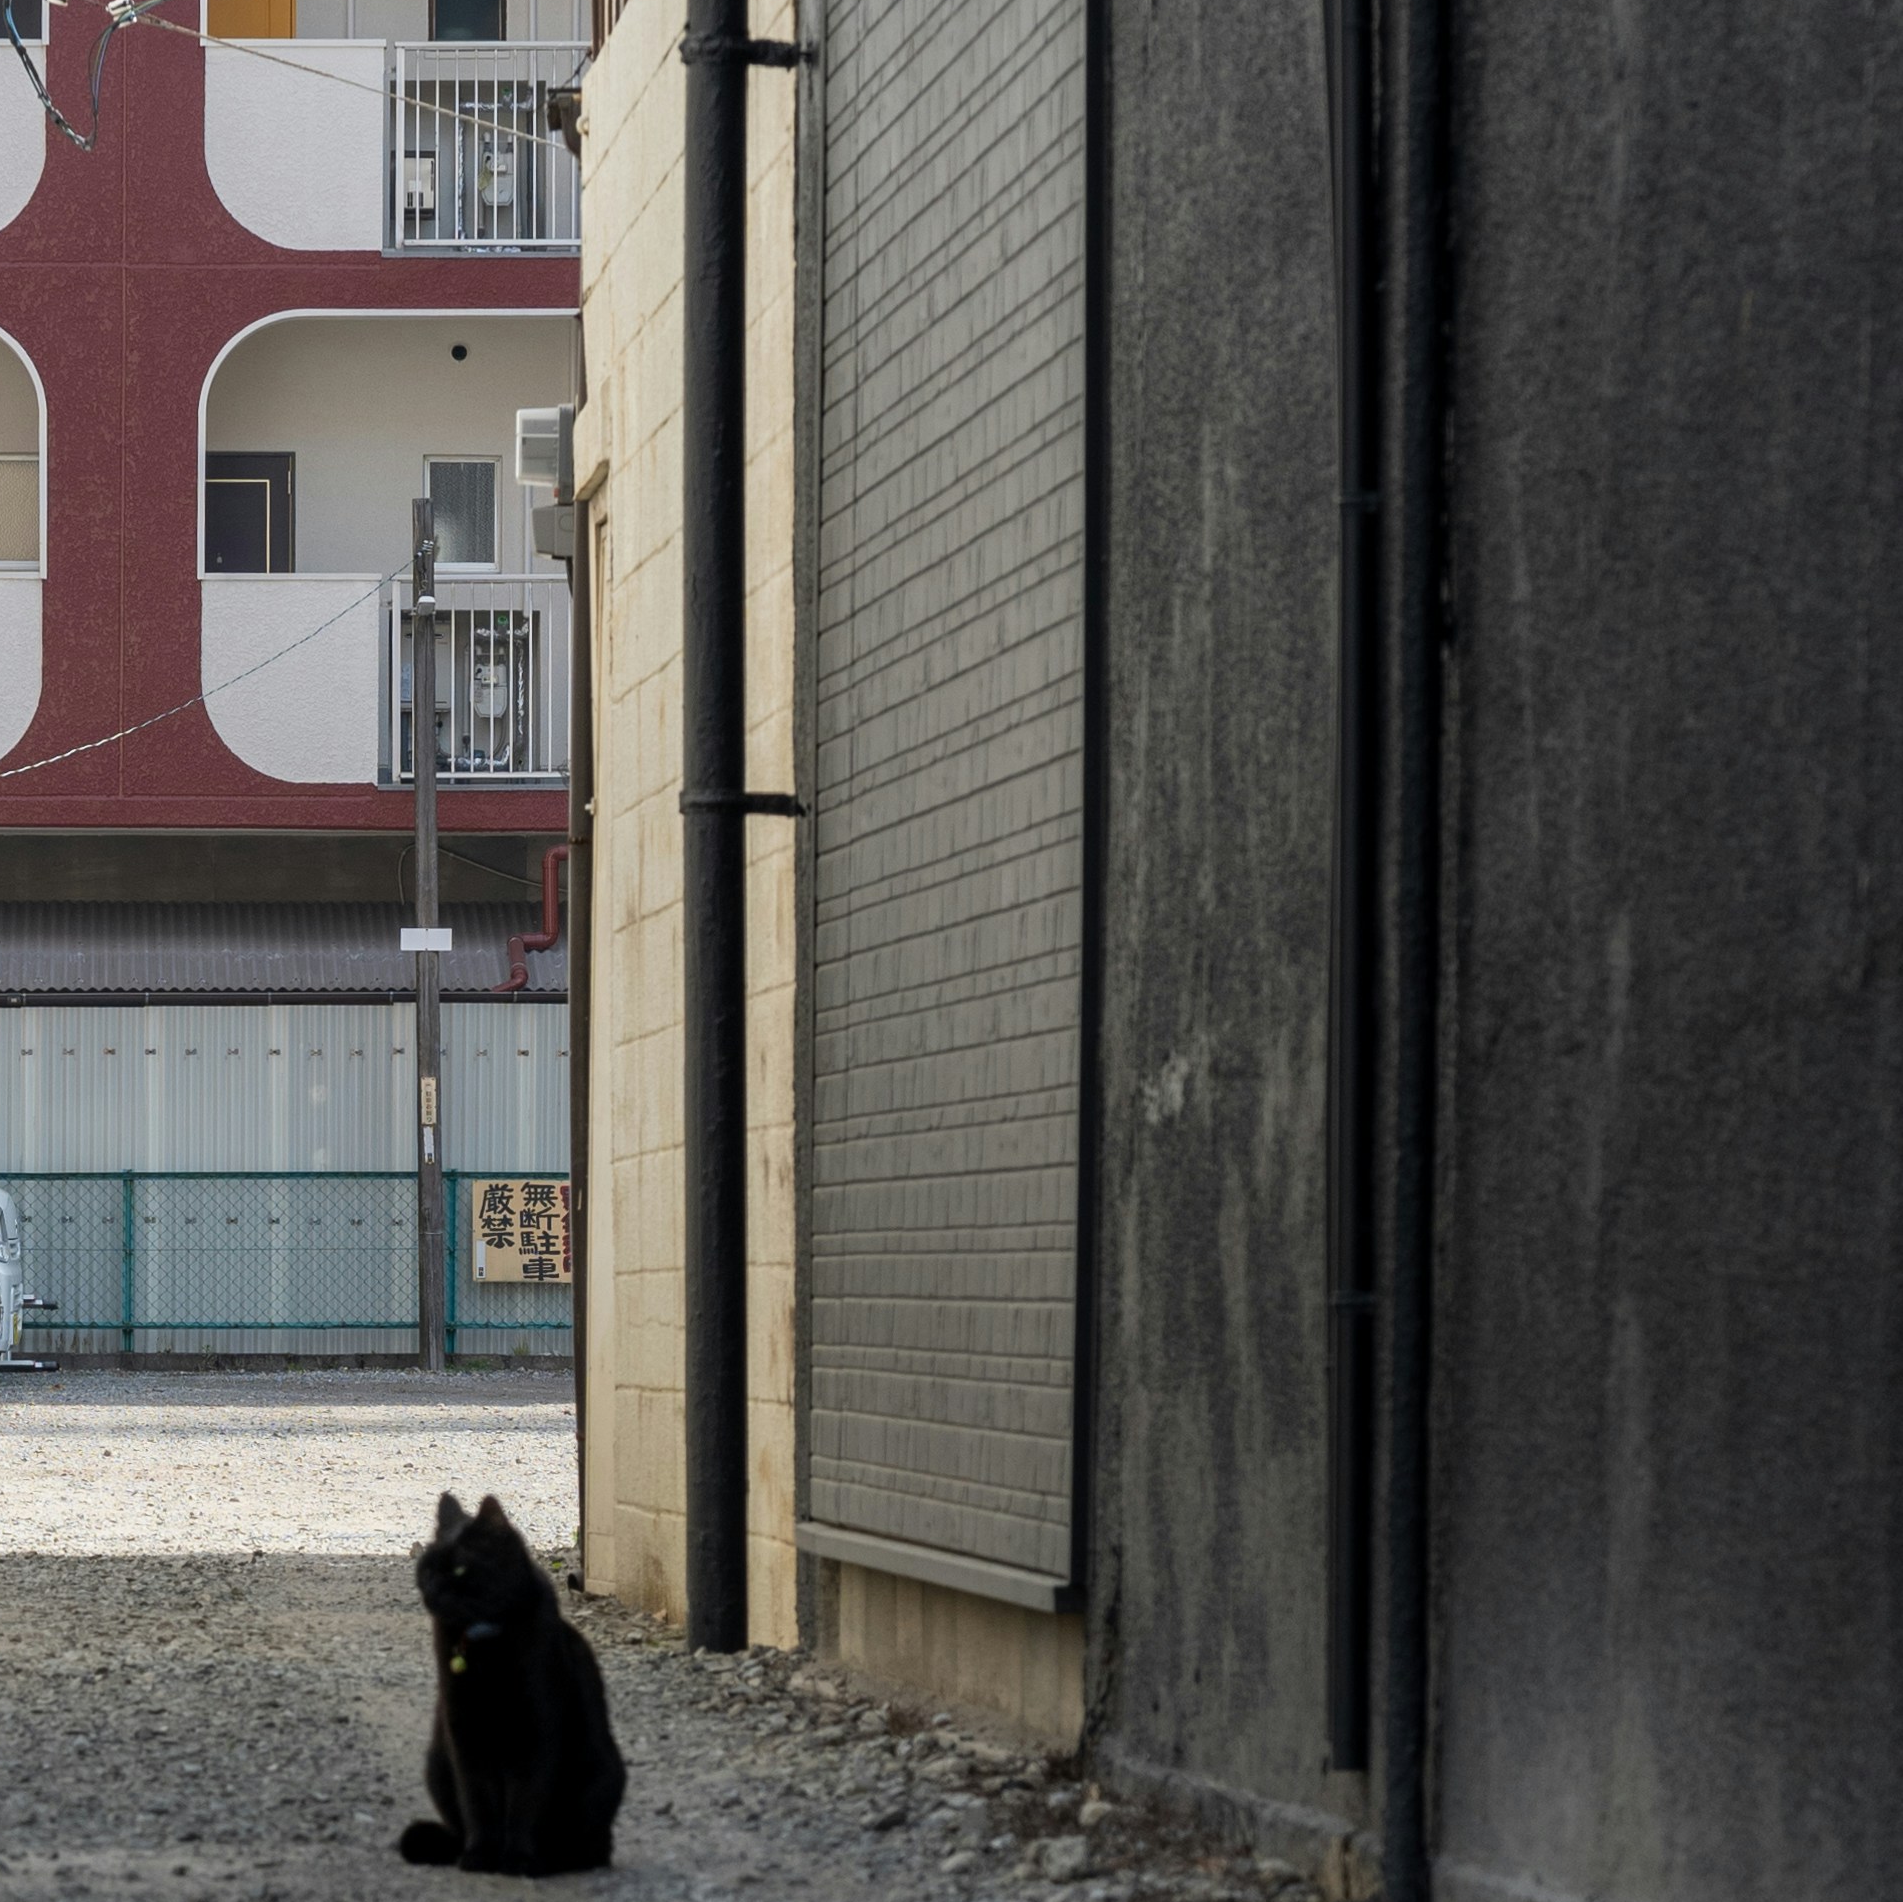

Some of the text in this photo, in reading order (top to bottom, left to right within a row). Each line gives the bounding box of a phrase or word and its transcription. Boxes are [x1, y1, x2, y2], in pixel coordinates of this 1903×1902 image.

[479, 1183, 516, 1249] 厳禁
[519, 1182, 561, 1281] 無断駐車
